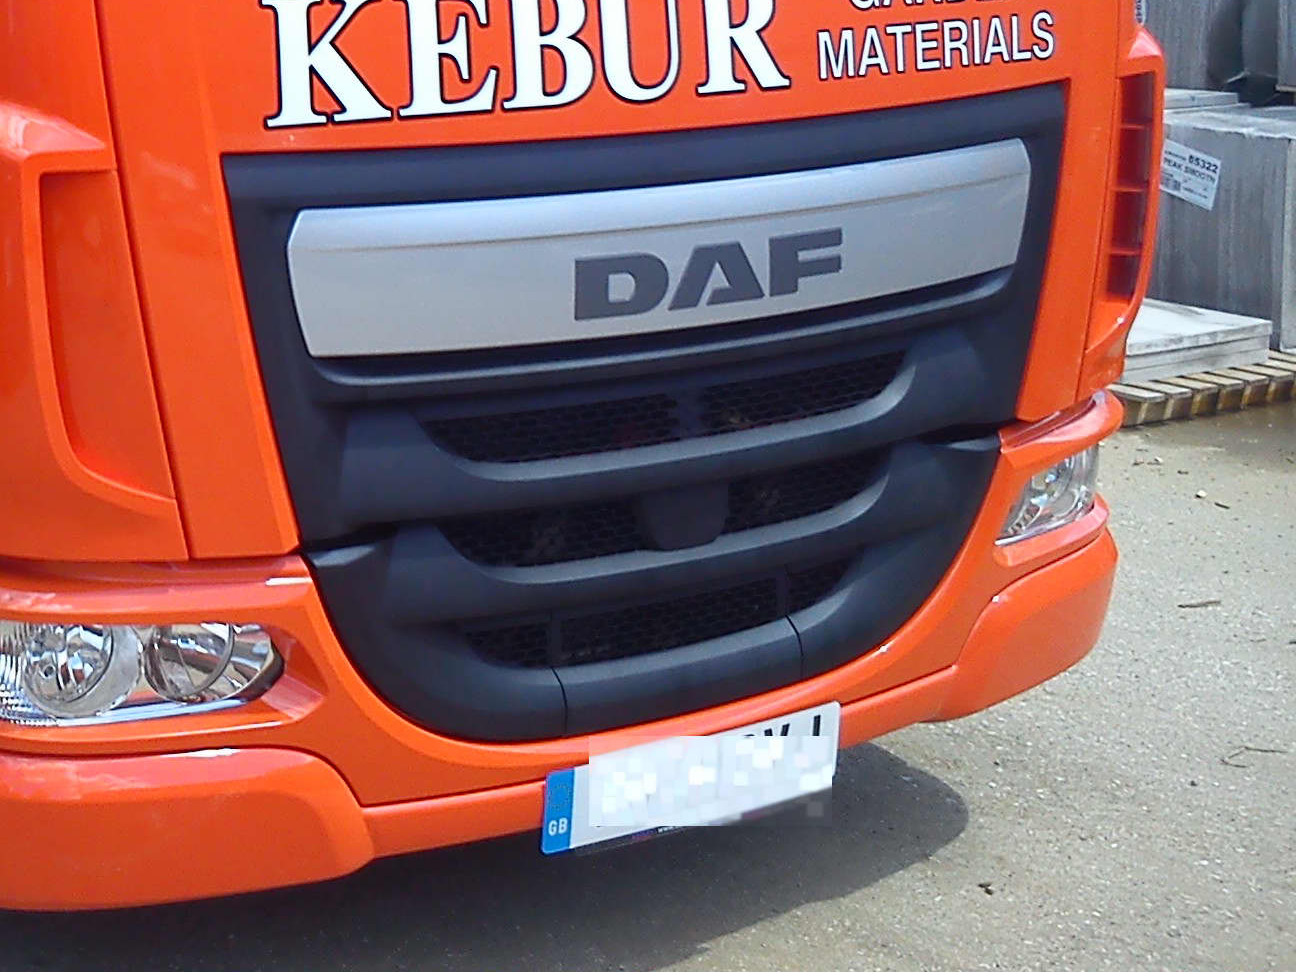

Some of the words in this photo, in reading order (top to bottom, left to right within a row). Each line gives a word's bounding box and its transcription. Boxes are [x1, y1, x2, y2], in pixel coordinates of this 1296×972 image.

[816, 10, 1056, 81] MATERIALS
[574, 228, 843, 321] DAF
[547, 816, 568, 835] GB
